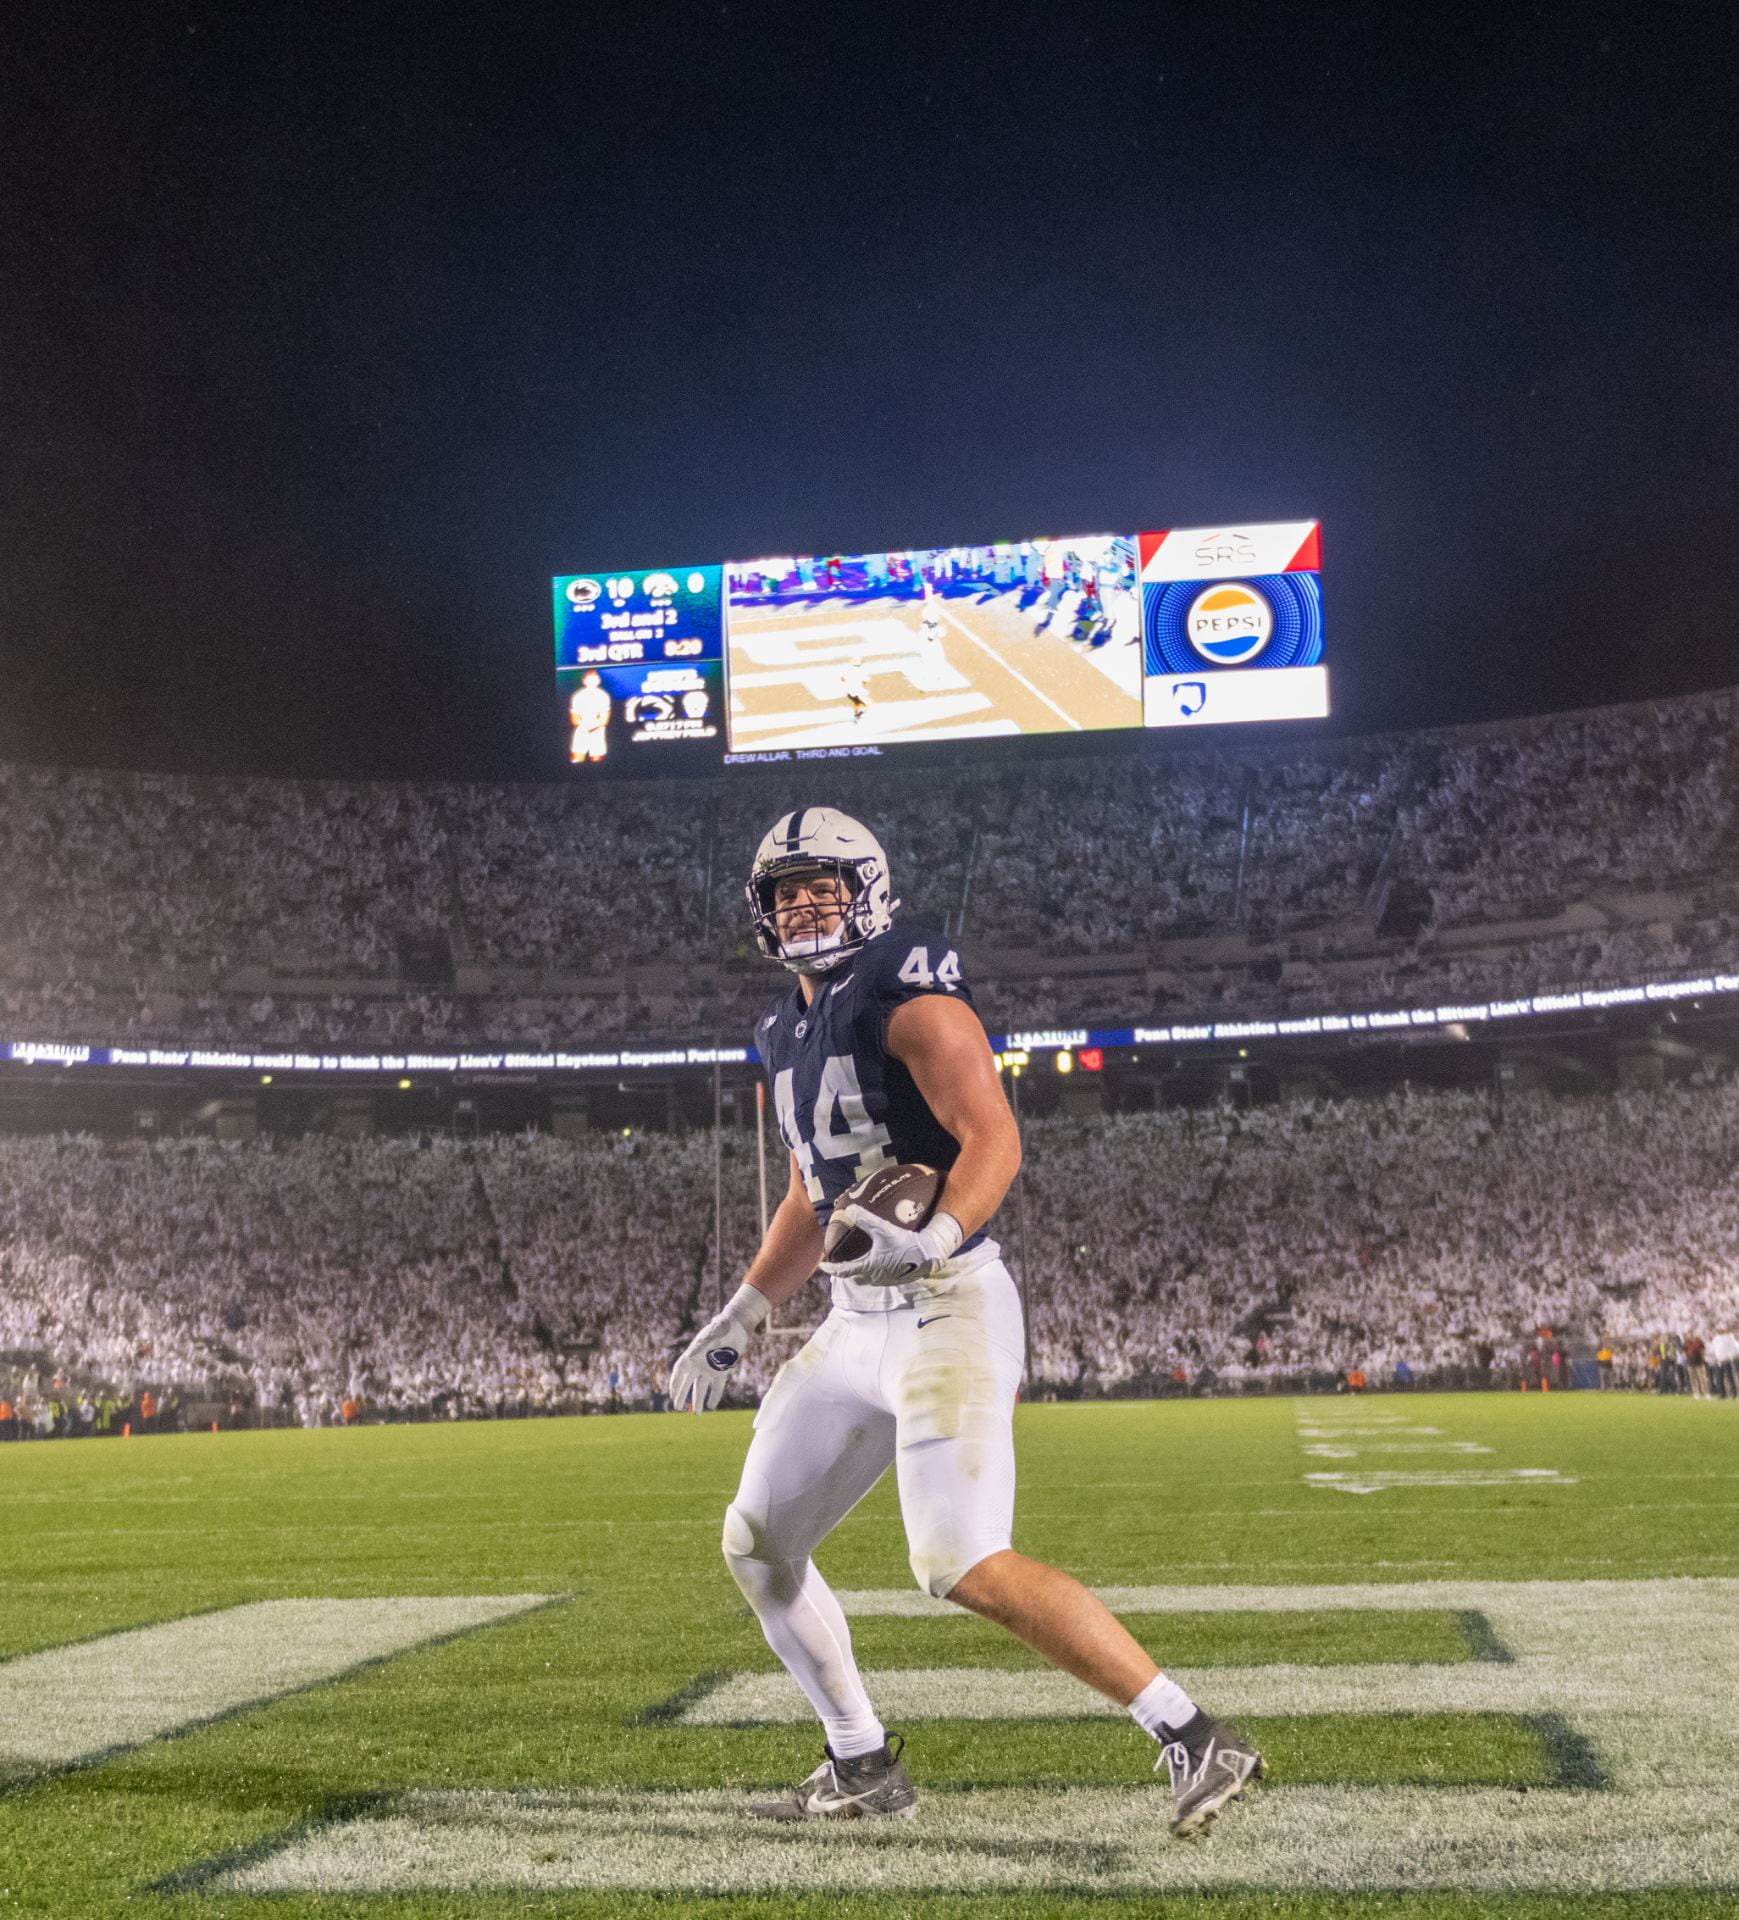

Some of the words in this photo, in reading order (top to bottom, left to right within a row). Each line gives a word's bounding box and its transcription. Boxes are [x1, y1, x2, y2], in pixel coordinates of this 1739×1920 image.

[1194, 544, 1257, 567] SRS
[605, 577, 634, 599] 10
[665, 608, 678, 625] 2
[1196, 616, 1262, 632] PEPSI
[608, 643, 643, 661] QTR
[724, 754, 756, 765] DREW
[795, 748, 827, 760] THIRD
[828, 747, 849, 758] AND
[897, 946, 963, 992] 44
